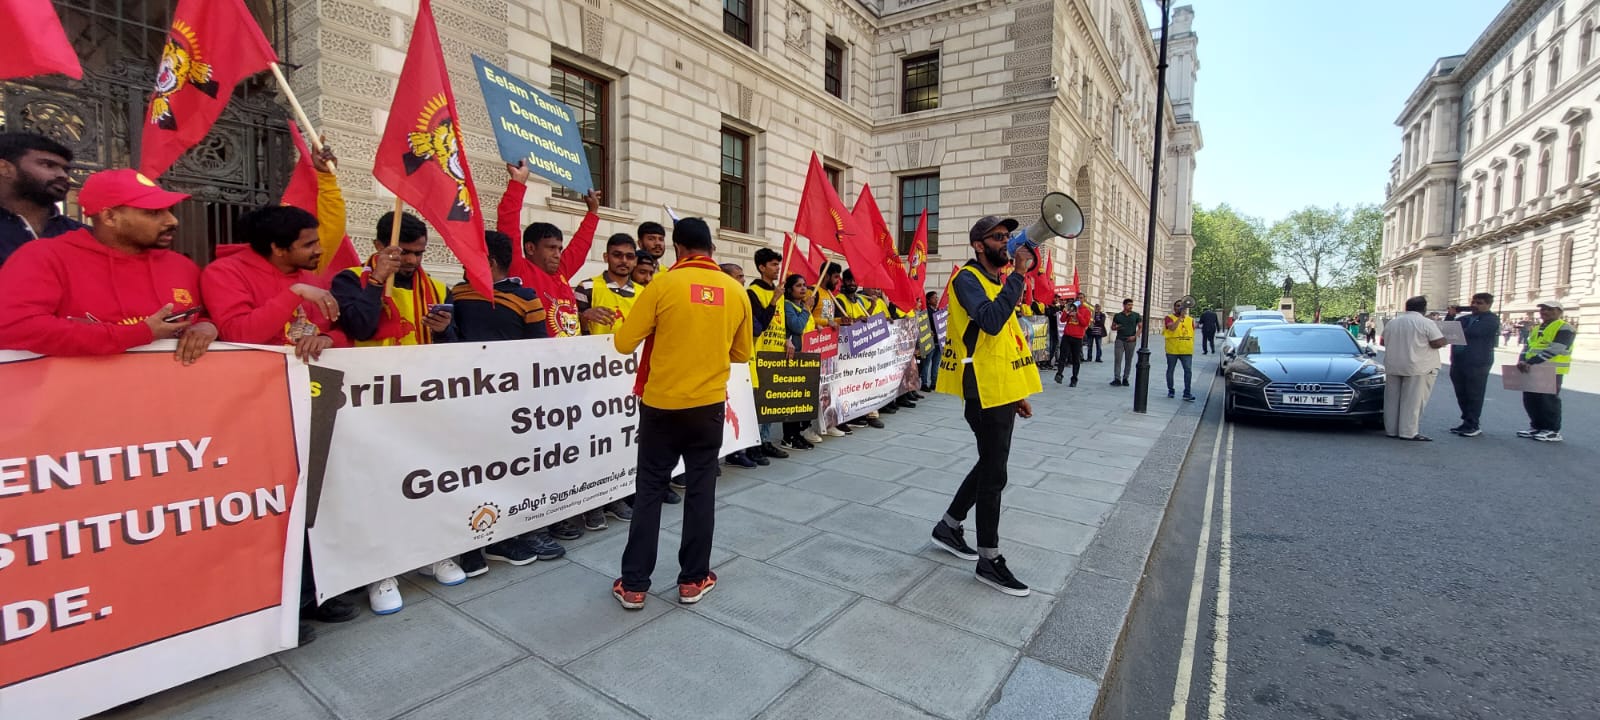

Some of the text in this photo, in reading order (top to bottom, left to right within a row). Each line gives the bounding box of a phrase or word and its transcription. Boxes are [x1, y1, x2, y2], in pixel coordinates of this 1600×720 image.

[484, 66, 570, 122] Eelam Tamils
[509, 99, 562, 136] Demand
[501, 117, 581, 165] International
[529, 152, 572, 180] Justice
[532, 352, 638, 389] Invaded
[758, 359, 820, 369] Boycott Sri Lanka
[773, 375, 806, 383] Because
[838, 383, 860, 397] Justice
[862, 380, 873, 390] for
[766, 390, 811, 399] Genocide is
[1288, 395, 1328, 404] YM17 YME
[511, 394, 641, 434] Stop ong
[761, 405, 813, 416] Unacceptable
[401, 442, 580, 500] Genocide
[590, 434, 612, 458] in
